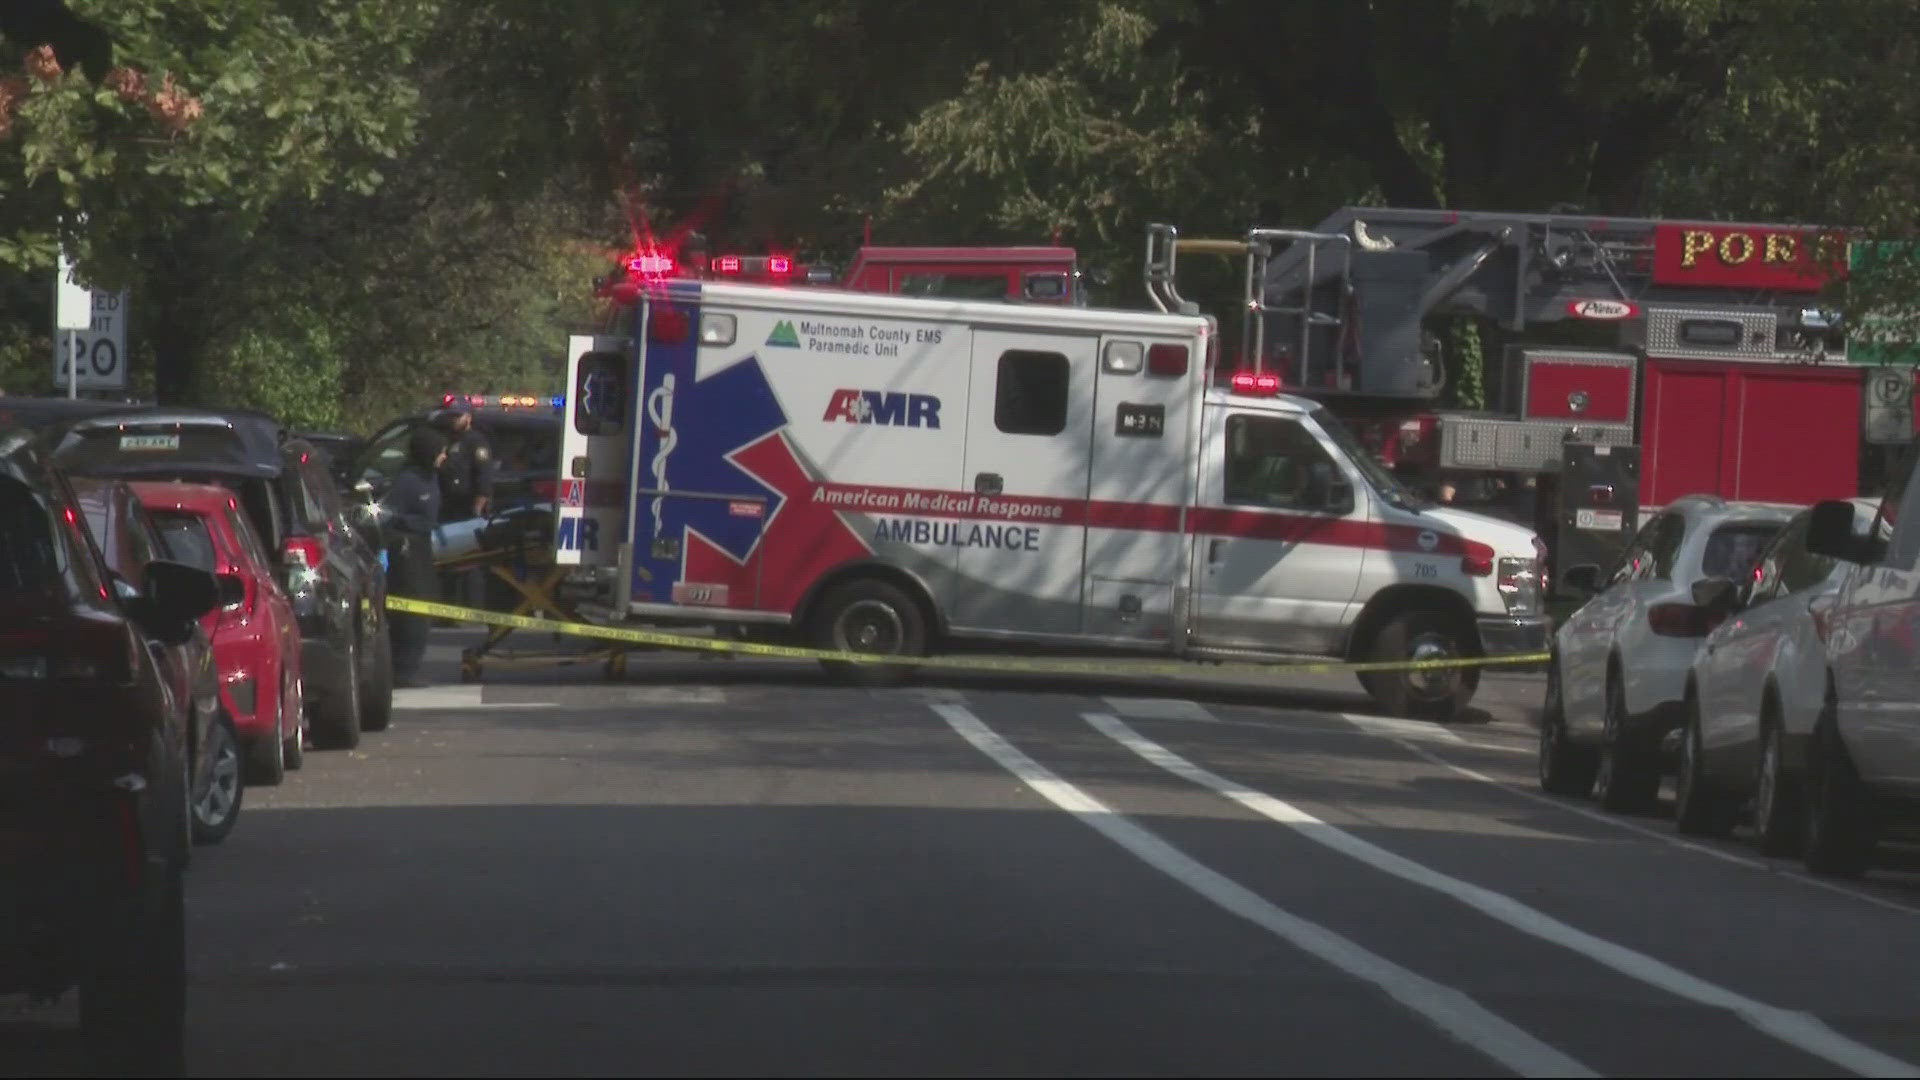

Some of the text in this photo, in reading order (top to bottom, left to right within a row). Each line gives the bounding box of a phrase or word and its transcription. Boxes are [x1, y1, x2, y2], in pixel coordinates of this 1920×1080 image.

[800, 320, 943, 344] Multnomah County EMS
[809, 338, 899, 357] Paramedic Unit
[62, 338, 117, 376] 20
[822, 388, 942, 430] AMR
[812, 485, 1063, 519] American Medical Response
[874, 518, 1041, 551] AMBULANCE
